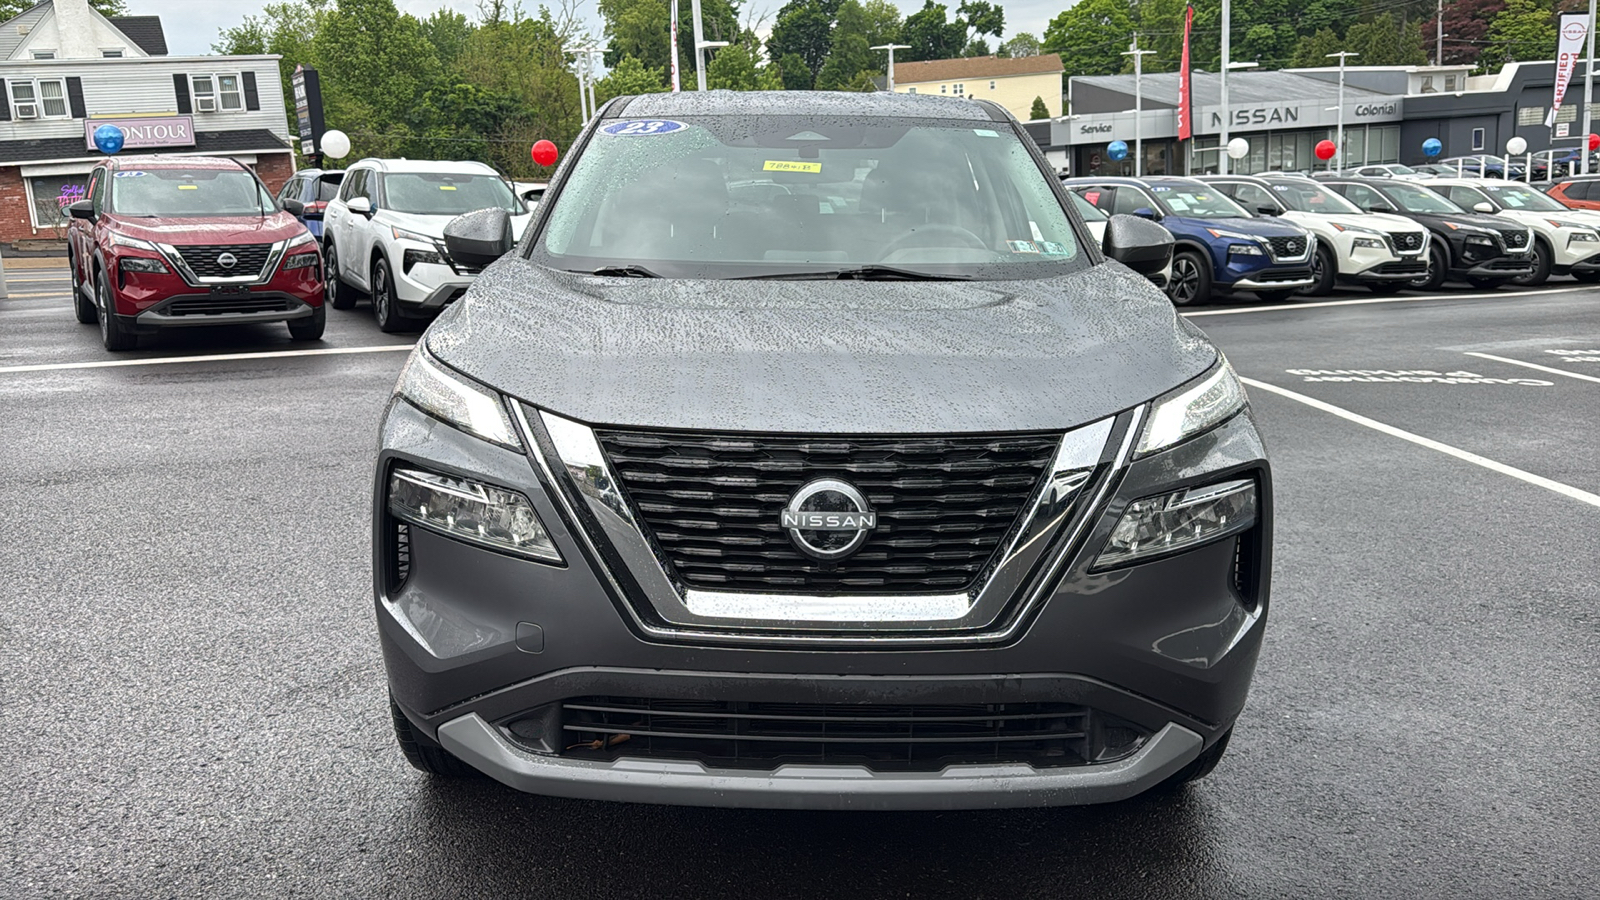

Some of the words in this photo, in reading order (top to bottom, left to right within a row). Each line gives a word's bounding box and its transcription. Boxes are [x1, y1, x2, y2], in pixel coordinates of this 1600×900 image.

[1553, 52, 1569, 111] CERTIFIED
[1211, 106, 1298, 128] NISSAN
[1354, 103, 1397, 117] Colonial
[118, 124, 187, 140] ONTOUR
[617, 122, 664, 134] 23
[1080, 123, 1113, 135] Service
[784, 514, 873, 527] NISSAN
